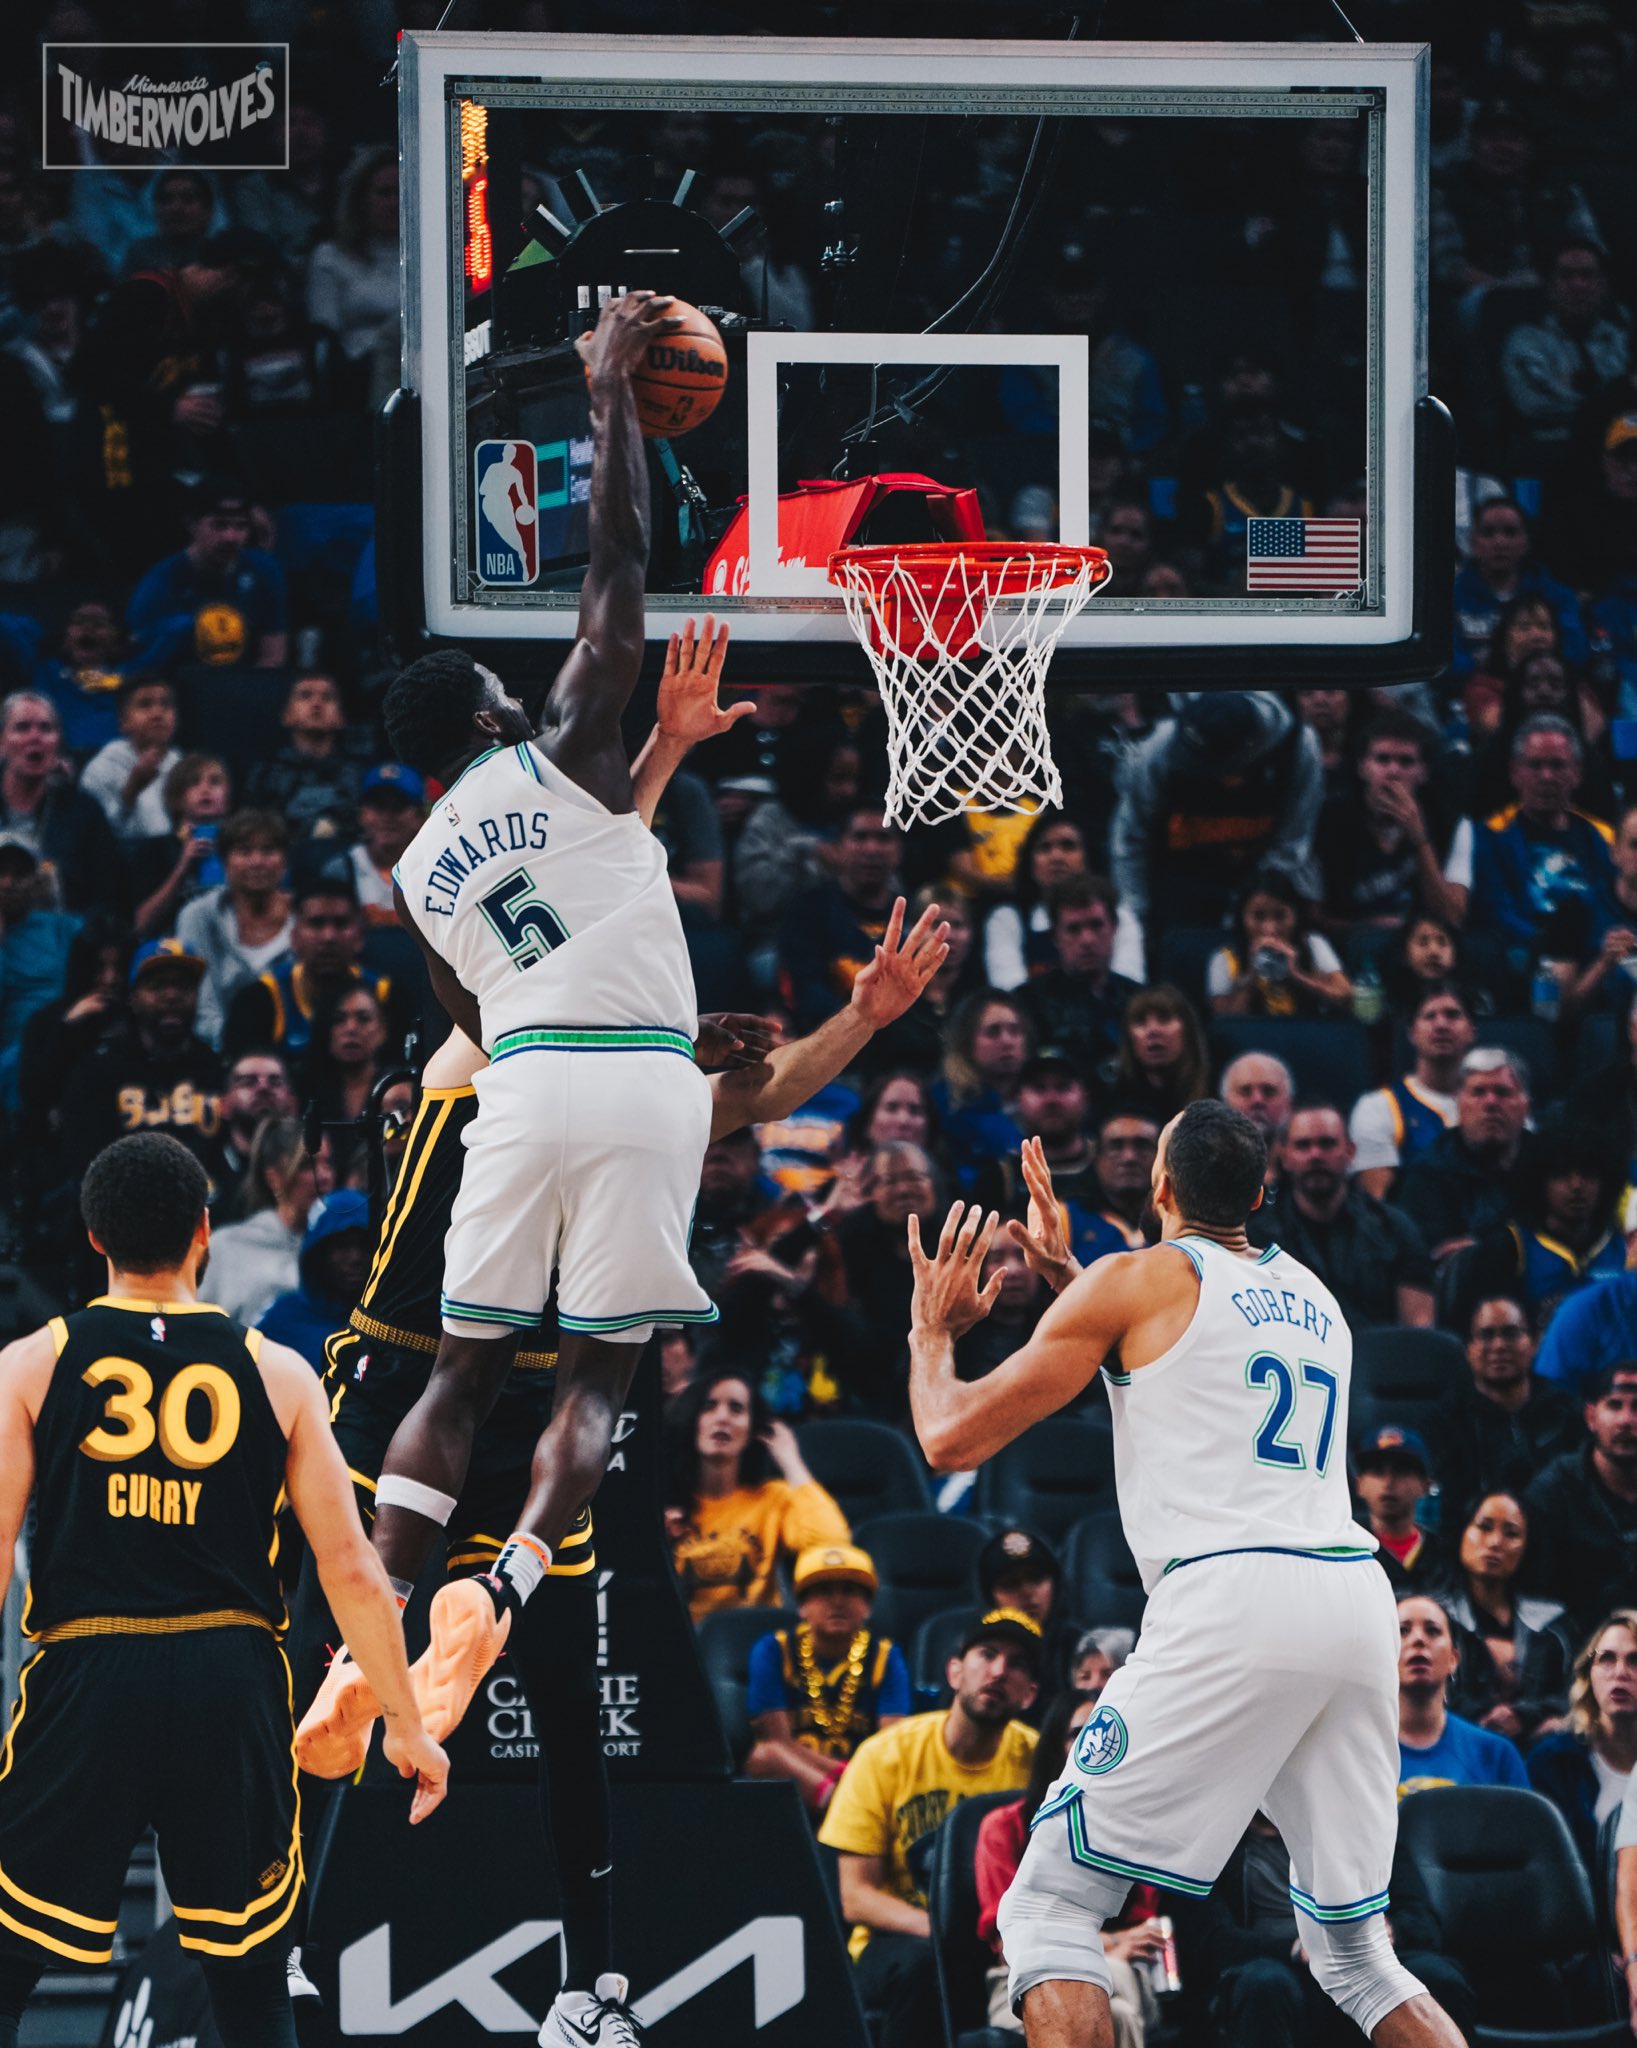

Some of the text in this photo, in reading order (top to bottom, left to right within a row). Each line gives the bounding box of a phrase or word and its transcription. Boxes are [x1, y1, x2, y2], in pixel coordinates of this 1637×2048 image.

[486, 553, 515, 575] NBA
[425, 812, 549, 918] EDWARDS
[475, 866, 571, 972] 5
[1231, 1288, 1332, 1344] GOBERT
[79, 1356, 241, 1470] 30
[1245, 1350, 1340, 1479] 27
[108, 1472, 202, 1525] CURRY
